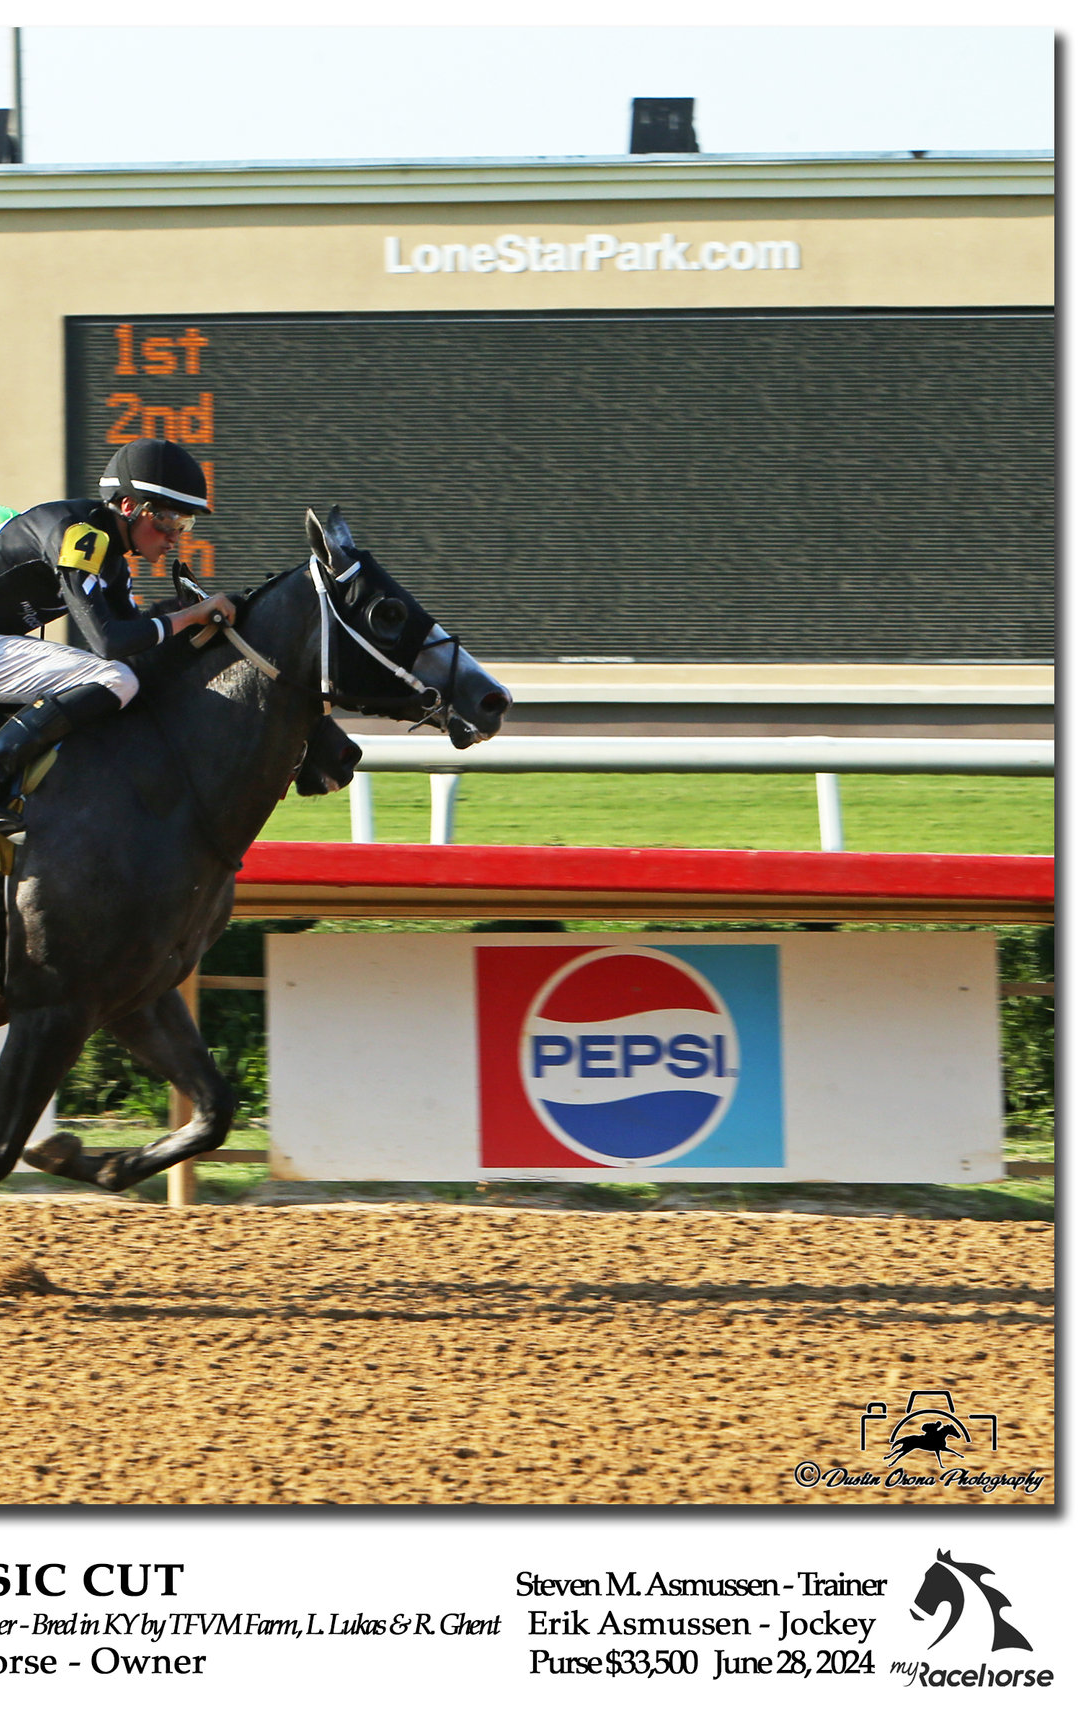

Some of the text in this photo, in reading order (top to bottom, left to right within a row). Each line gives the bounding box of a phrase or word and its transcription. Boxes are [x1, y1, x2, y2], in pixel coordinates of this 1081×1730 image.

[384, 233, 802, 273] LoneStarPark.com
[113, 324, 210, 375] 1st
[105, 392, 215, 444] 2nd
[75, 531, 98, 562] 4
[530, 1033, 728, 1079] PEPSI
